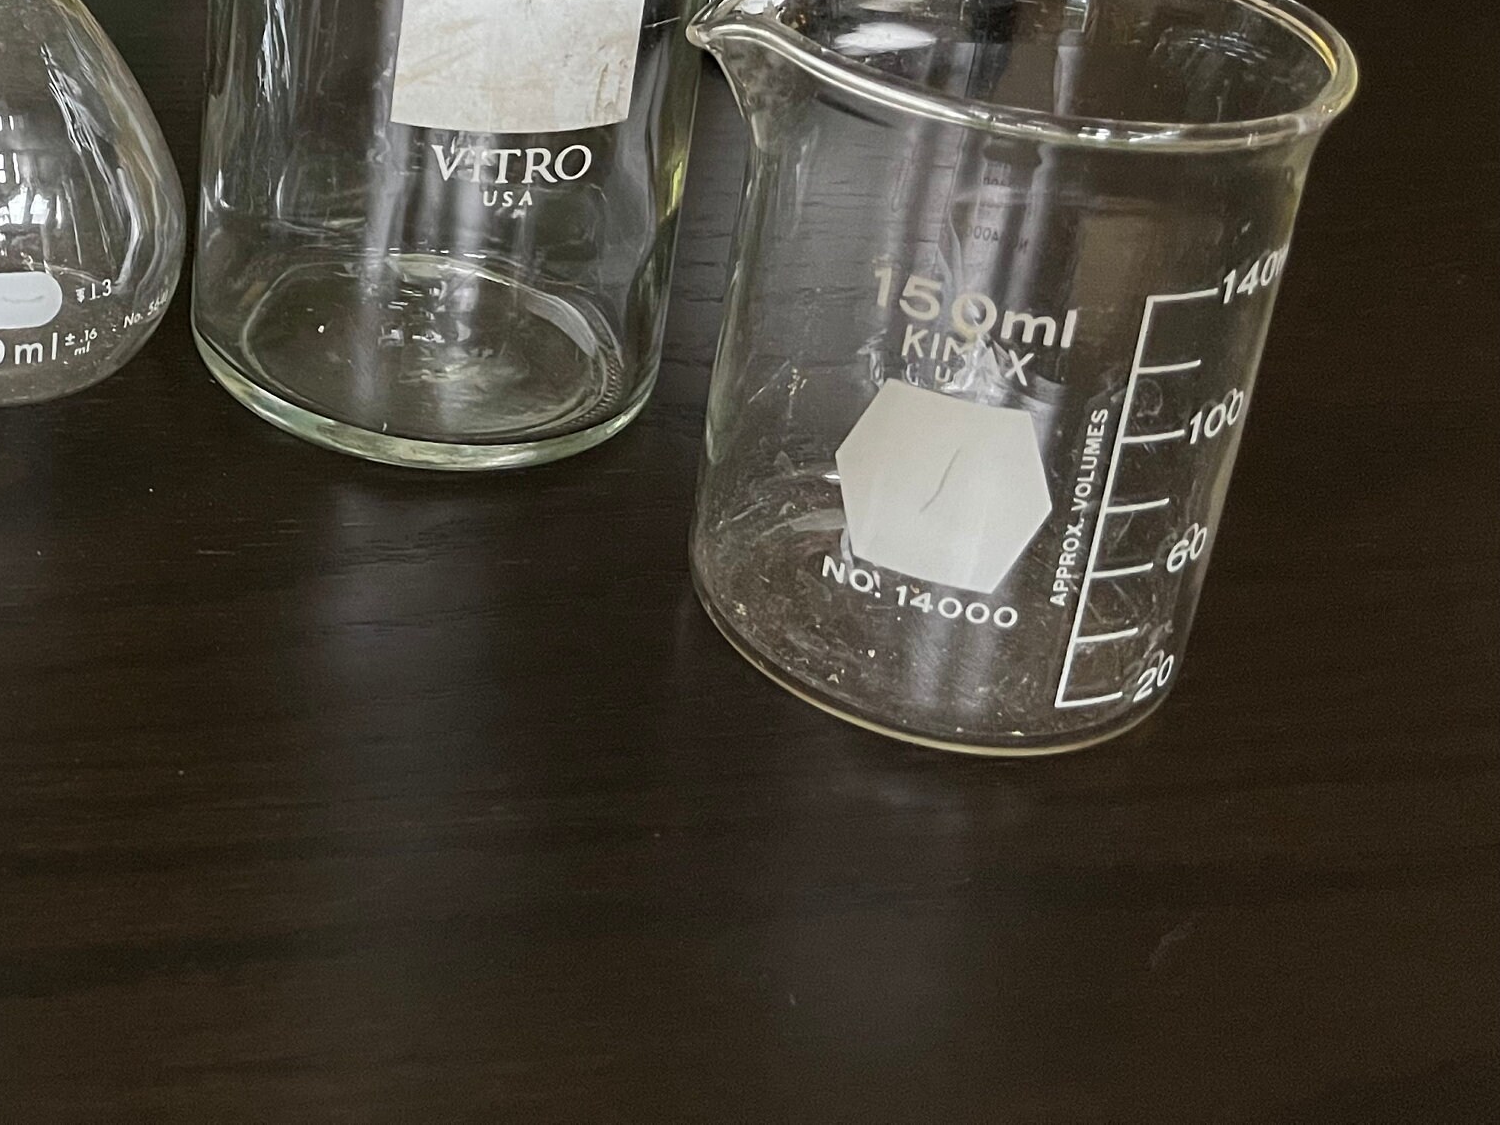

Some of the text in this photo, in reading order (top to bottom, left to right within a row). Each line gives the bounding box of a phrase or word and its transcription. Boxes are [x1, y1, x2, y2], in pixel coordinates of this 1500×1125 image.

[431, 144, 593, 183] VITRO
[482, 190, 534, 207] USA
[1223, 250, 1280, 304] 140
[14, 332, 58, 365] ml
[1189, 390, 1244, 445] 100
[1071, 408, 1109, 512] VOLUMES
[1166, 526, 1208, 573] 60
[896, 585, 1018, 628] 14000
[1133, 654, 1175, 703] 20
